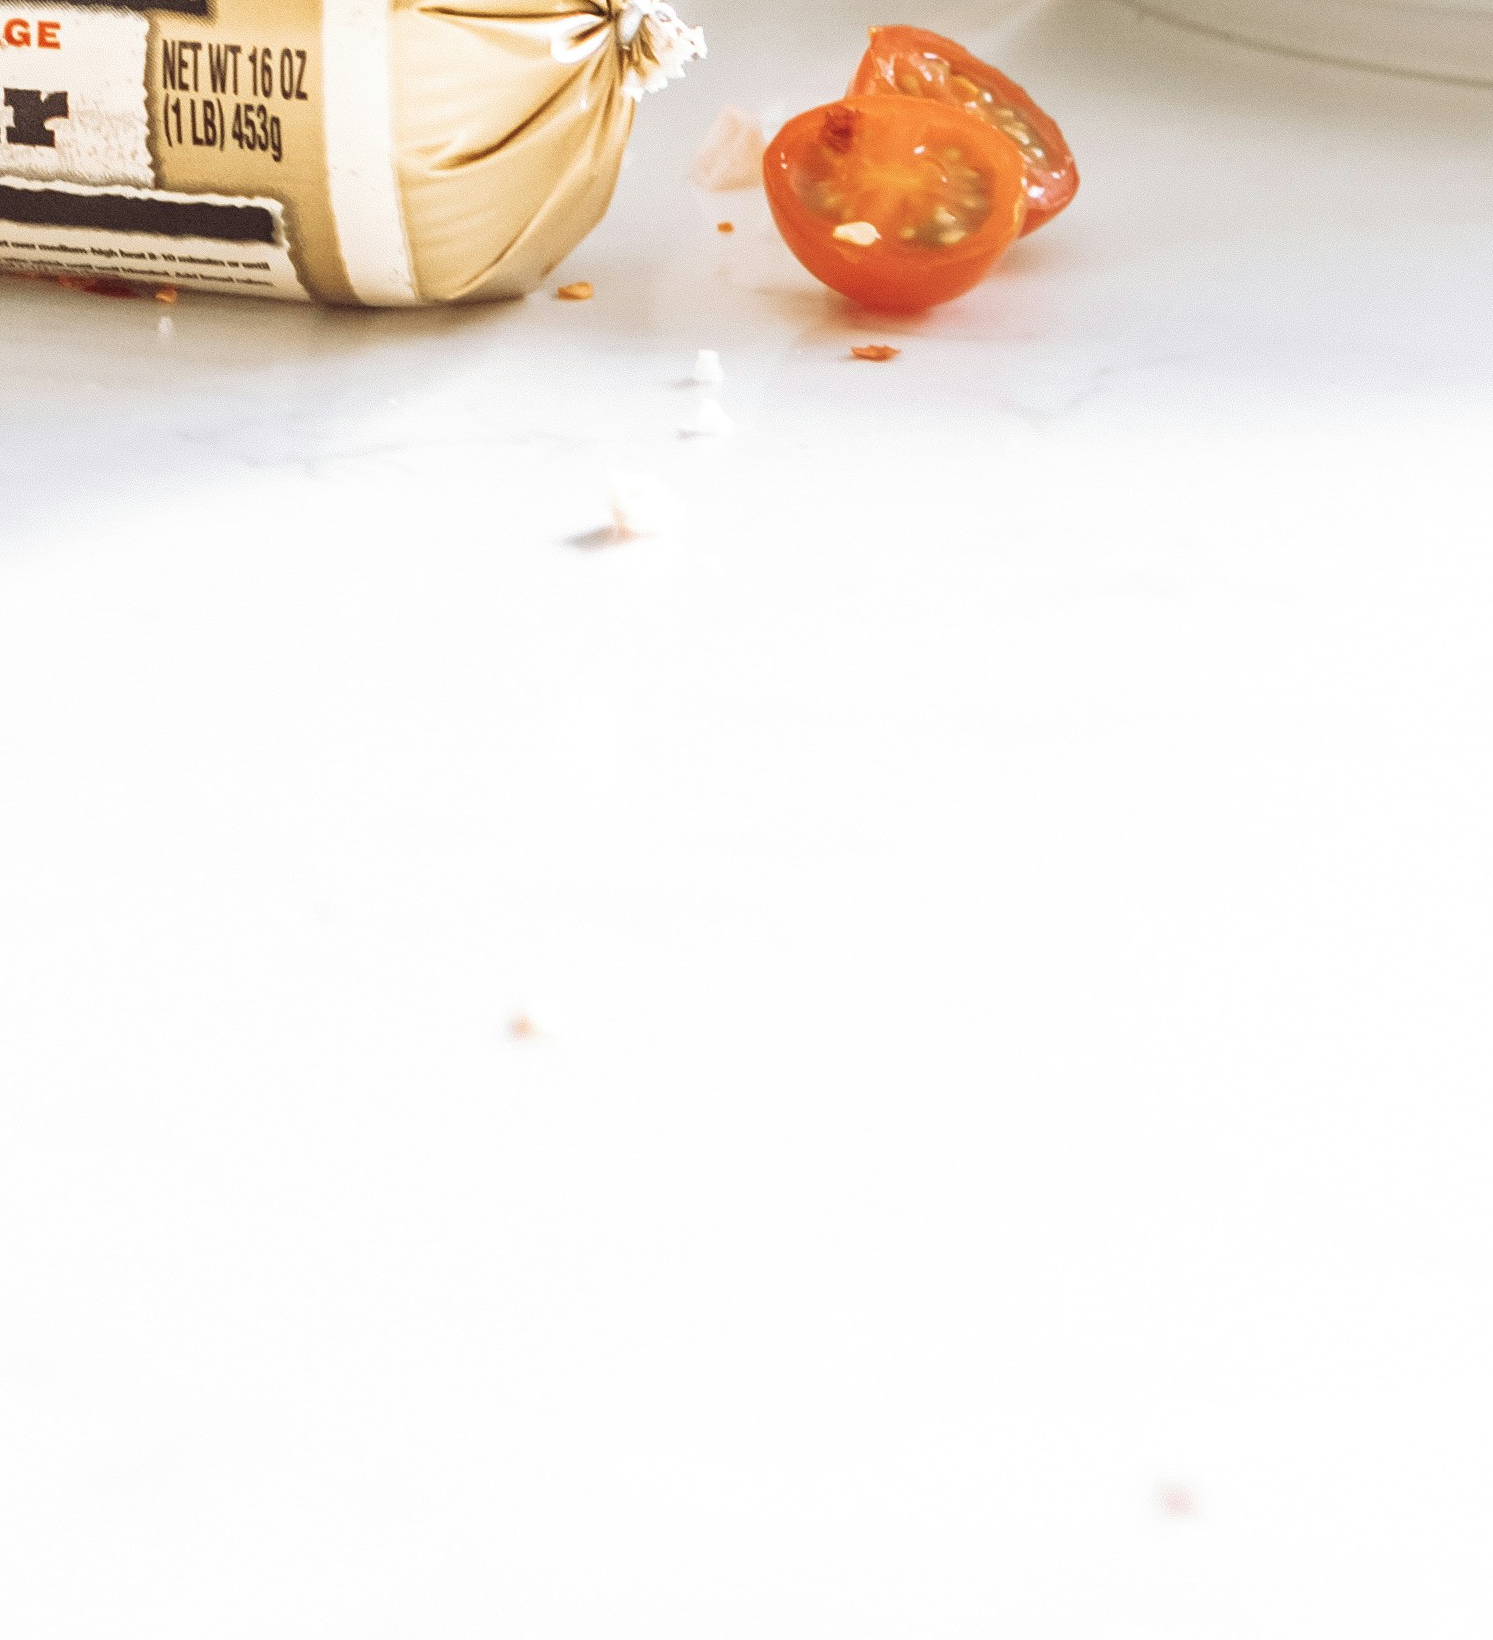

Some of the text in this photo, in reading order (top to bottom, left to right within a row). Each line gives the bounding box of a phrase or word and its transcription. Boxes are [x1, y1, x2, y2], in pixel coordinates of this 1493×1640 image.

[161, 38, 309, 102] NET WT 16 OZ
[162, 95, 283, 163] (1 LB) 453g
